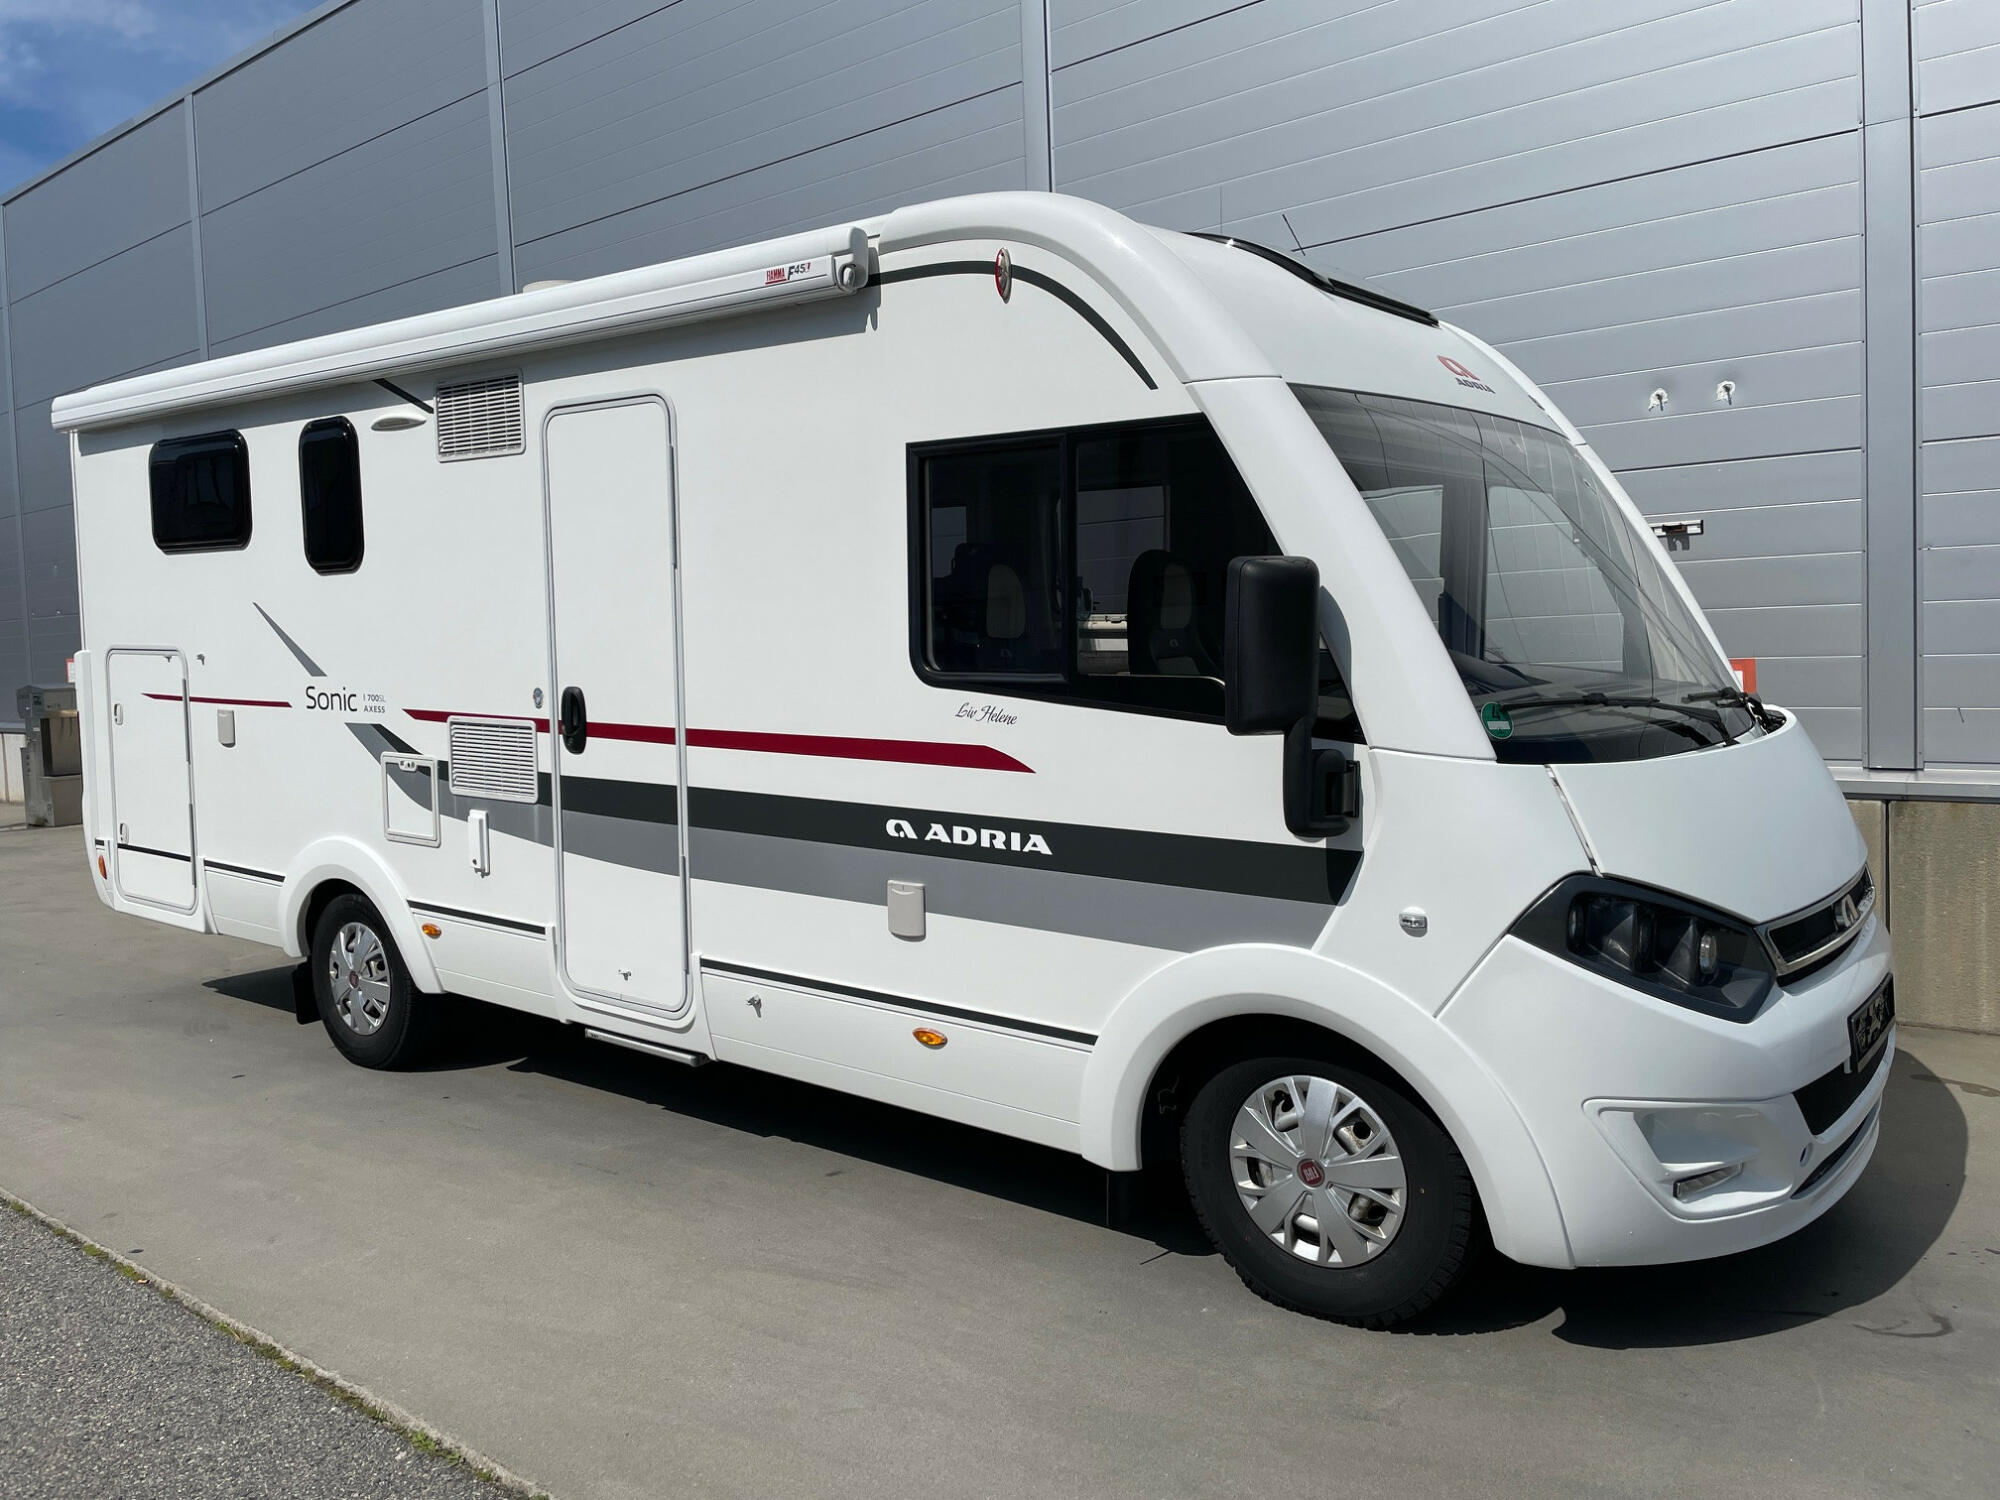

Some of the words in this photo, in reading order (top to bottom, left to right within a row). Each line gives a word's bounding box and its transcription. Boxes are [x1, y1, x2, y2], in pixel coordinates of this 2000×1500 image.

[1455, 377, 1496, 394] ADRIA
[305, 685, 358, 712] Sonic
[363, 704, 386, 714] AXESS
[976, 705, 1018, 725] Helene
[924, 822, 1053, 856] ADRIA
